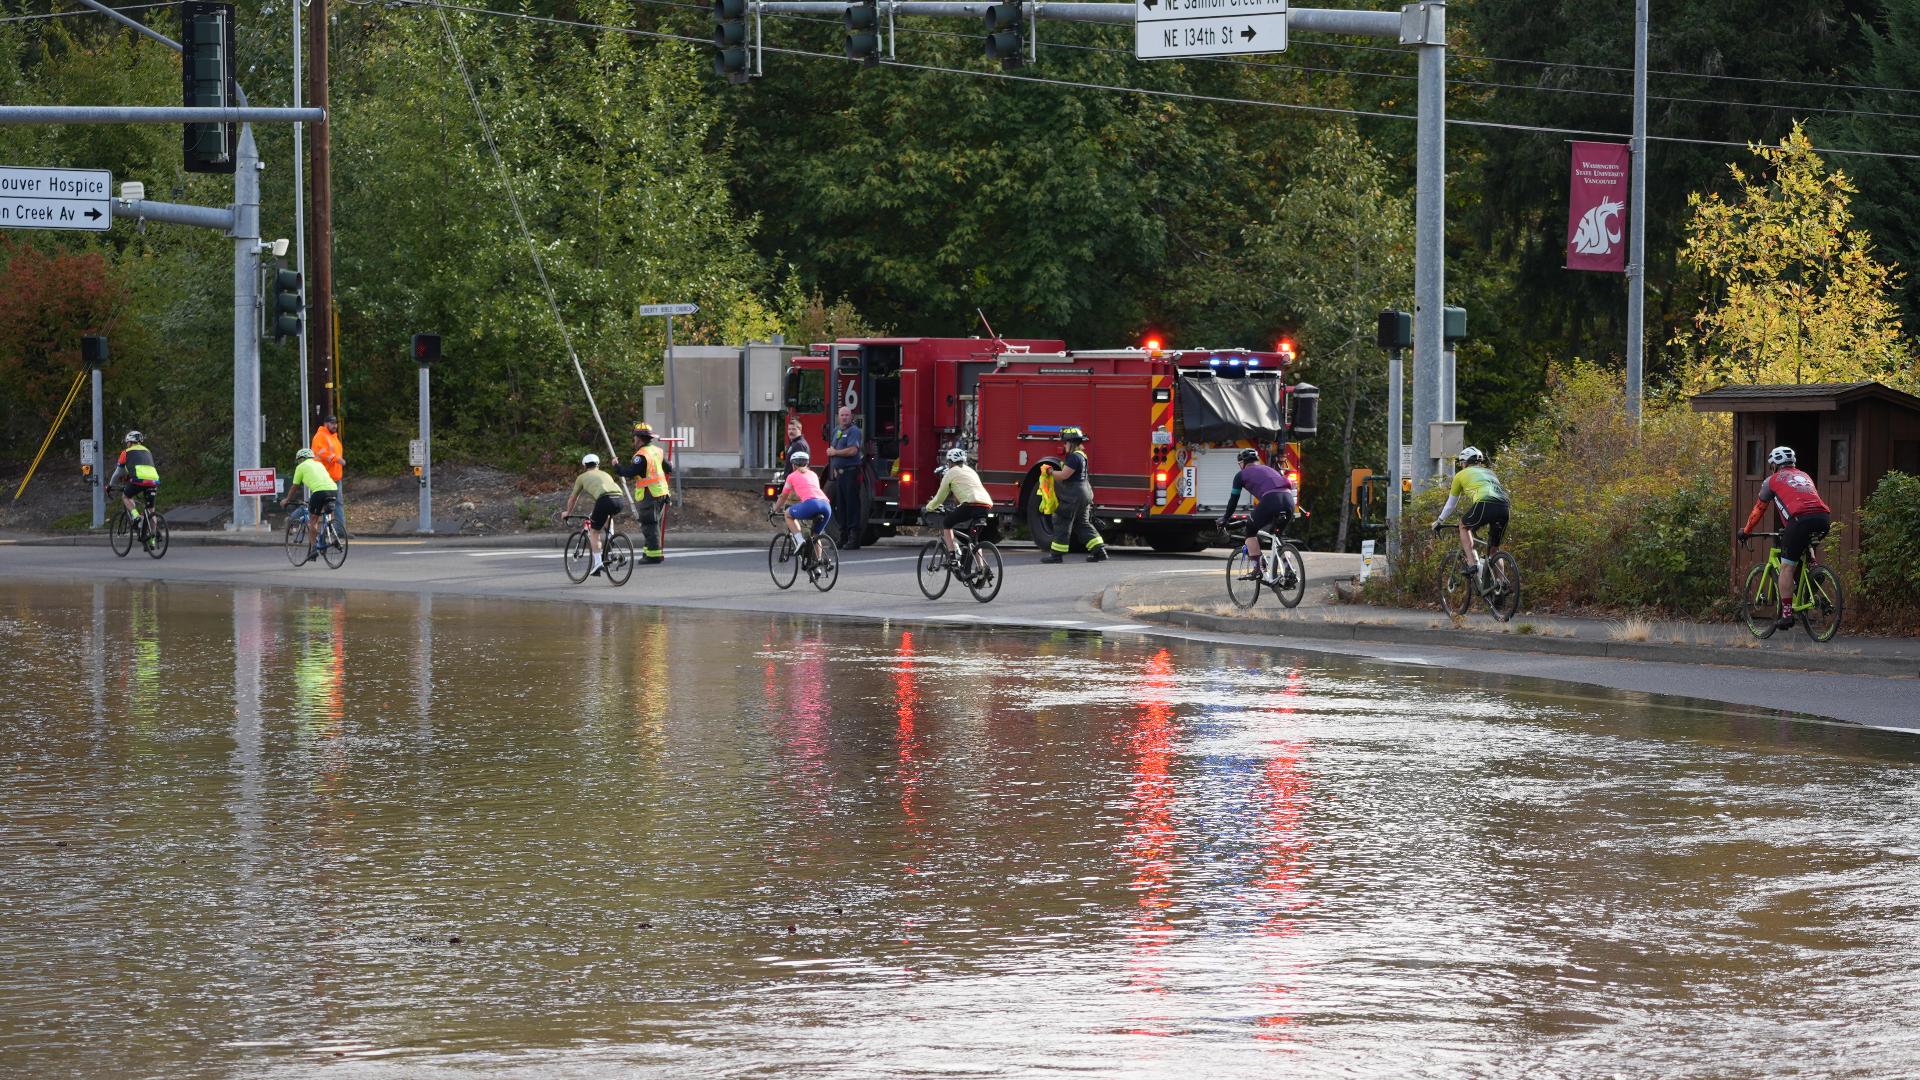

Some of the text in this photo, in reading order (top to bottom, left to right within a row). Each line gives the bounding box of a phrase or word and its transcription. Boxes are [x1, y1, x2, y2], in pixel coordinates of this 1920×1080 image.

[1165, 0, 1179, 10] NE
[1164, 26, 1233, 47] NE 134th St
[2, 177, 103, 196] ouver Hospice
[0, 204, 75, 220] n Creek Av
[845, 380, 858, 410] 6
